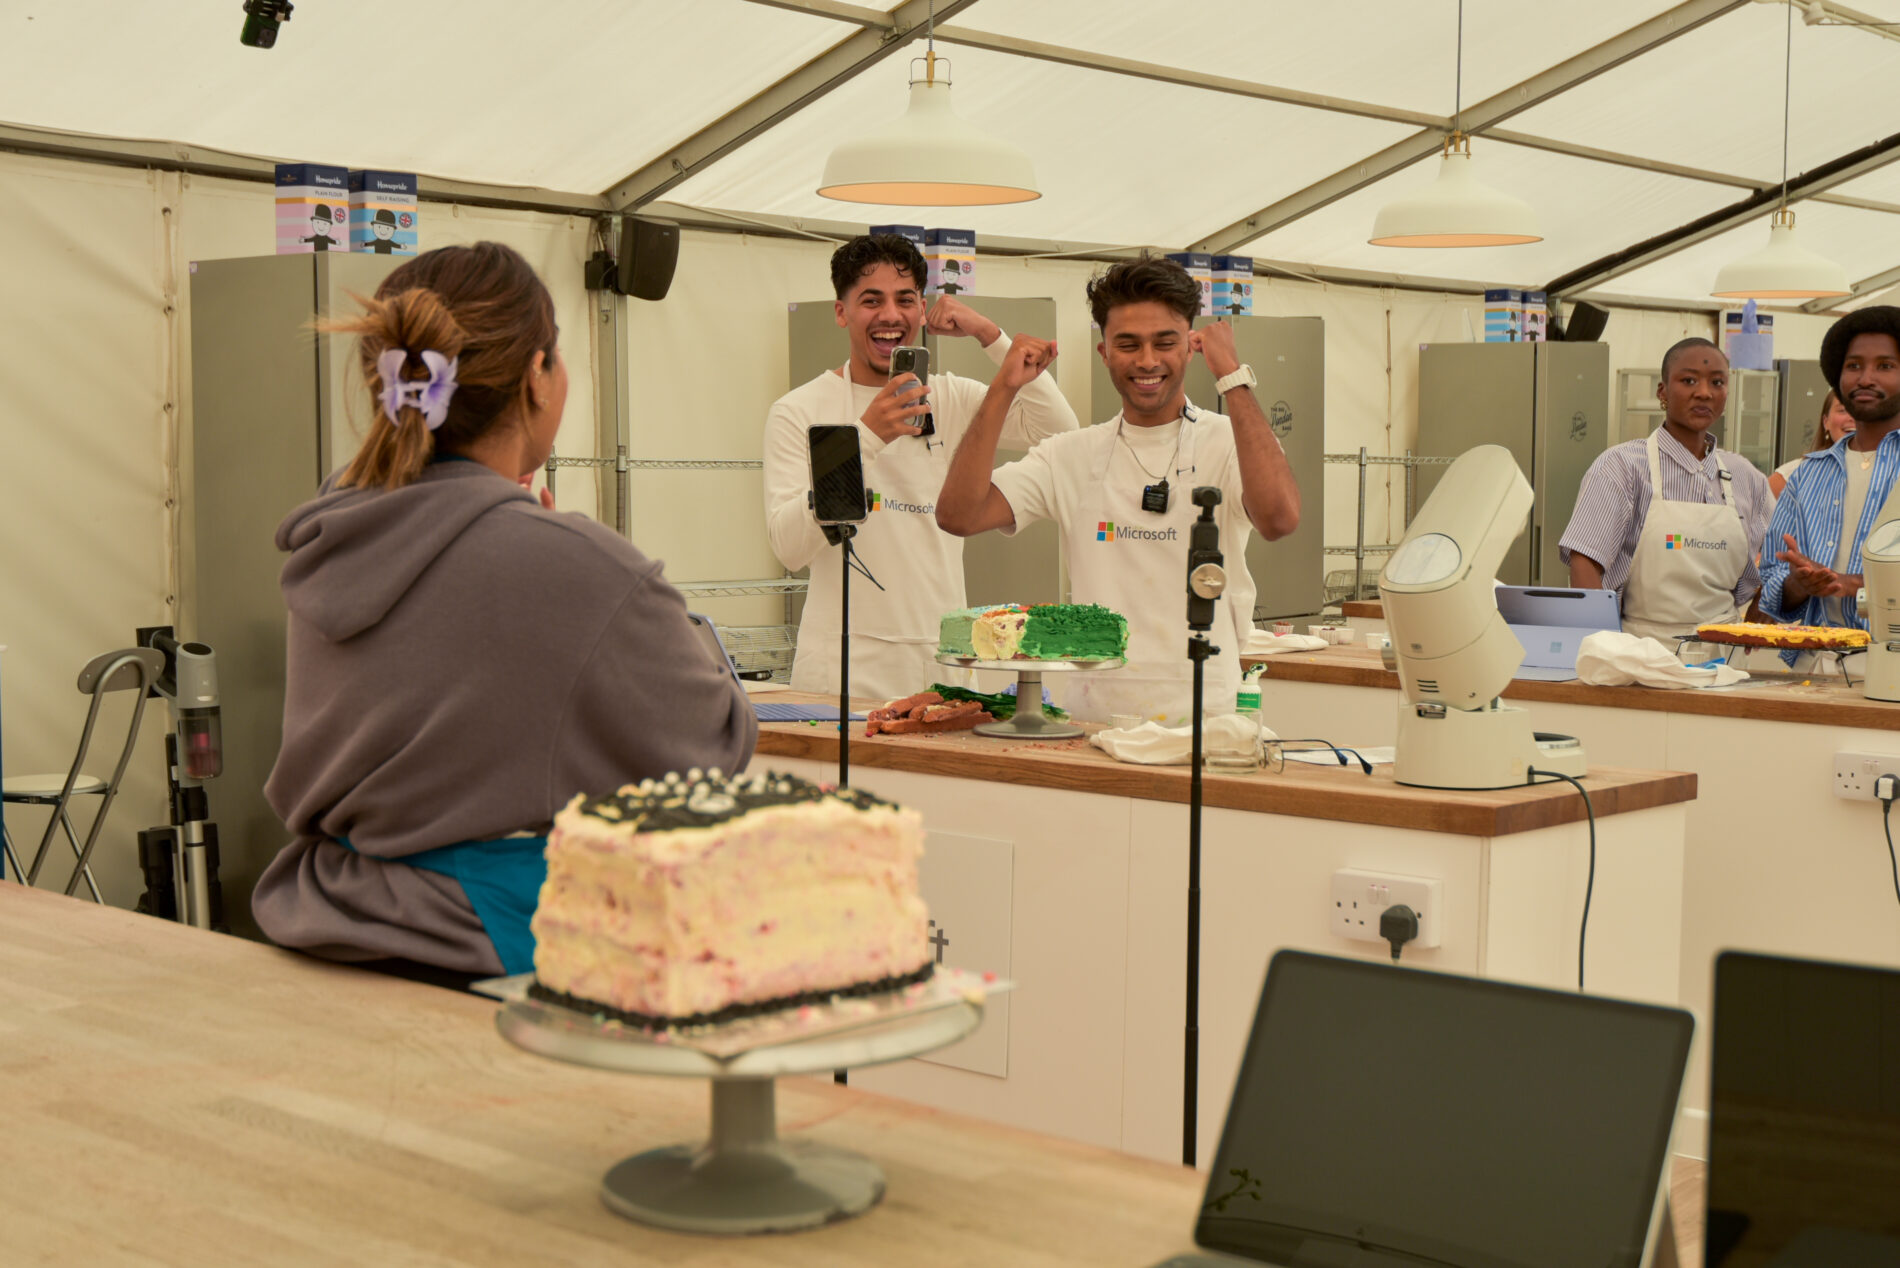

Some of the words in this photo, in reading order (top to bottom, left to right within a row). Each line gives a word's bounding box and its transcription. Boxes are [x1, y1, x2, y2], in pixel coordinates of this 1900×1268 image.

[377, 180, 407, 190] Homepride
[1116, 525, 1178, 541] Microsoft
[1684, 537, 1727, 550] Microsoft
